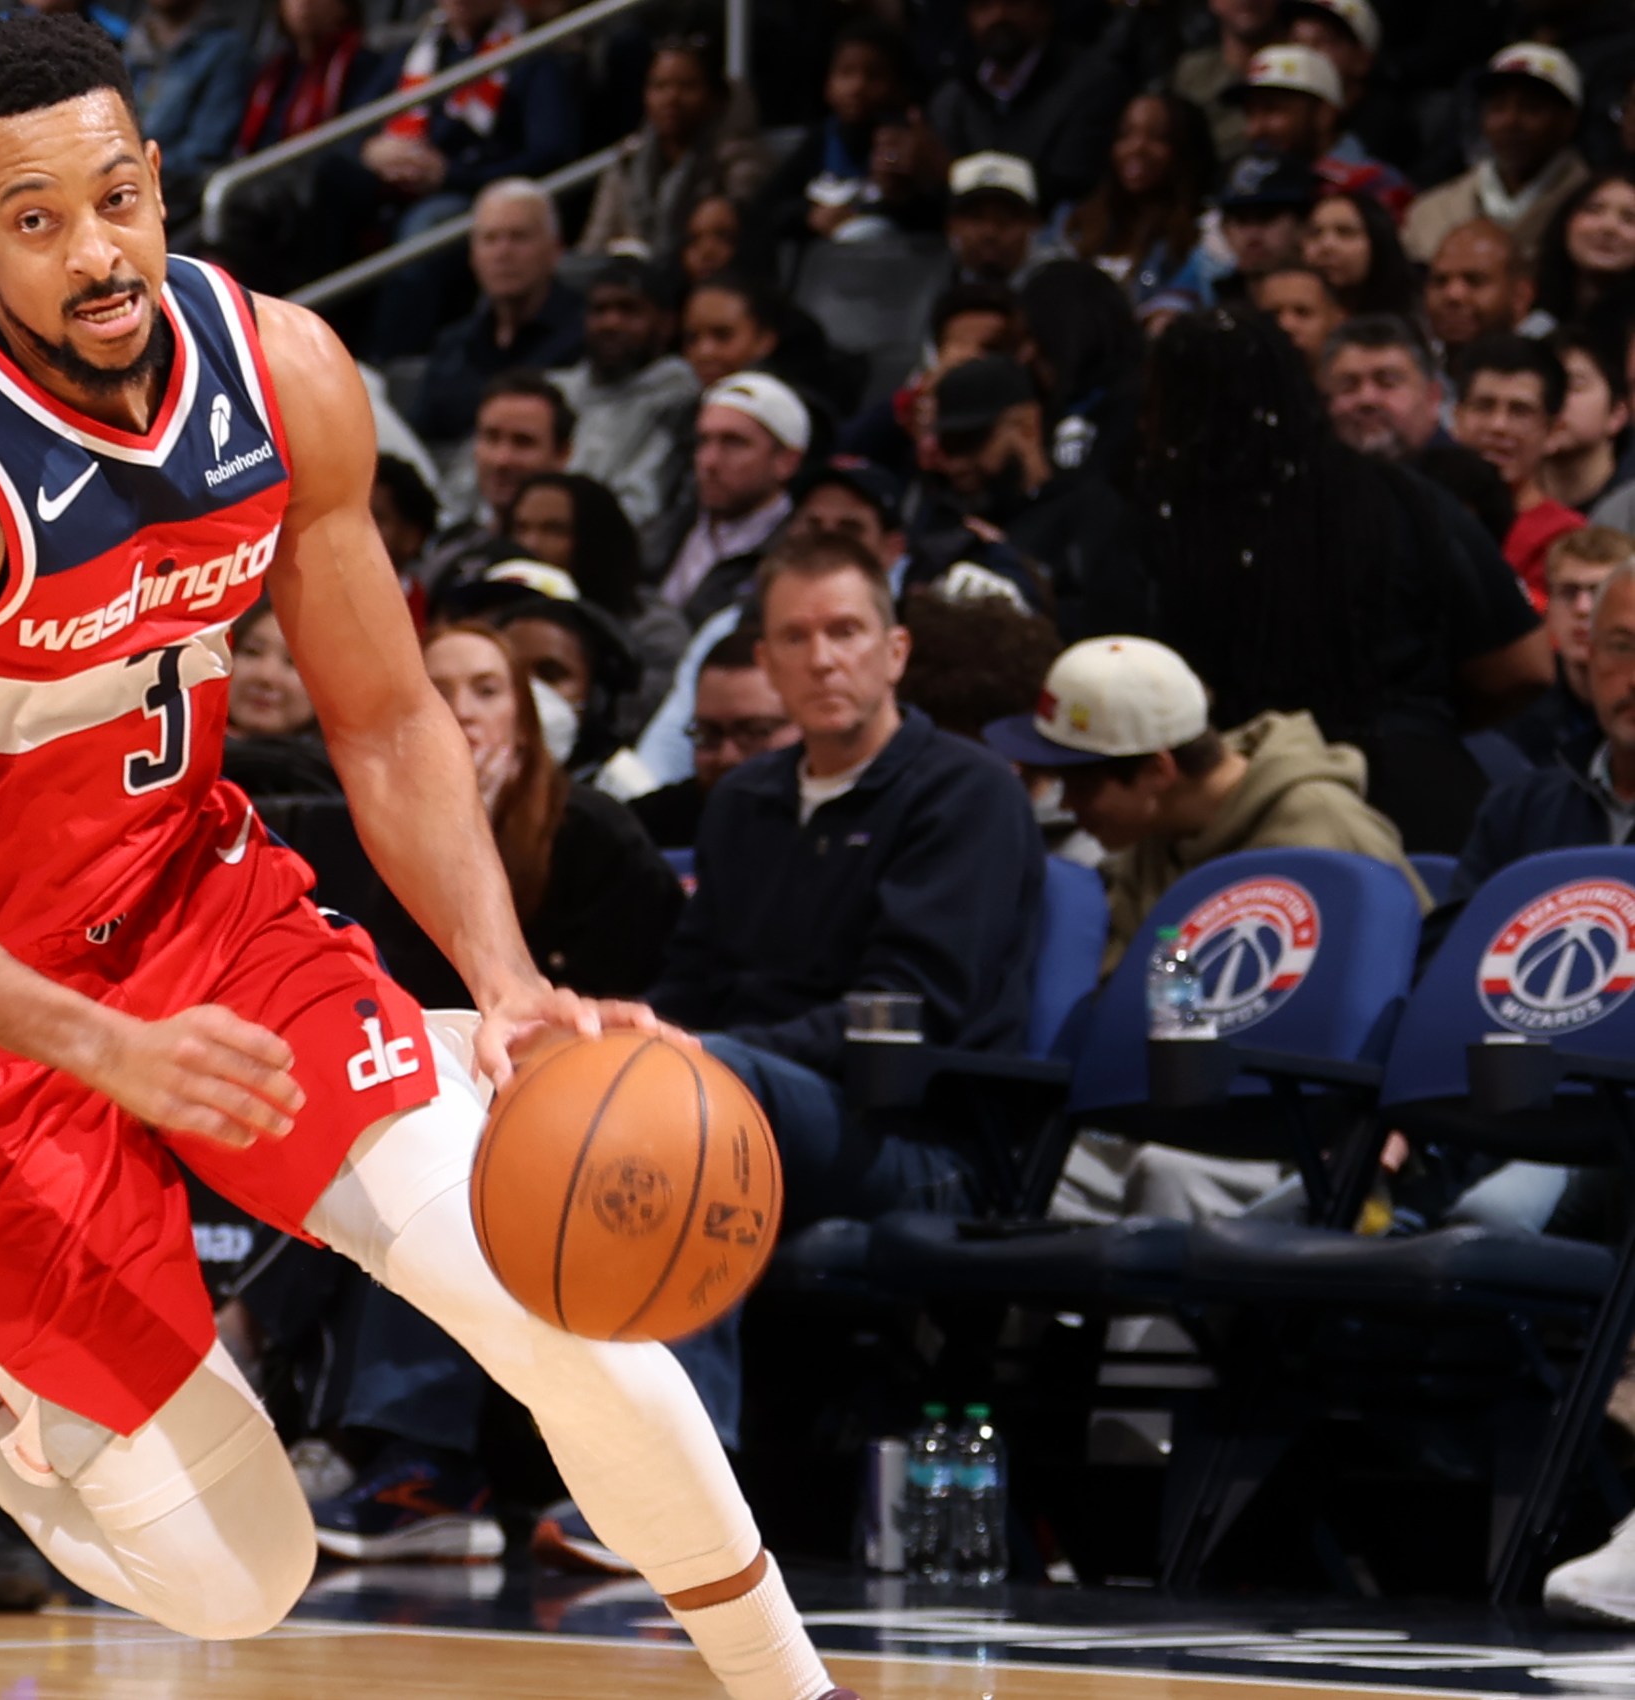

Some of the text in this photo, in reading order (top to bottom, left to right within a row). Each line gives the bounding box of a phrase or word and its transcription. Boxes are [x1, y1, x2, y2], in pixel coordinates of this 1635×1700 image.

[204, 441, 274, 488] Robinhood
[18, 523, 282, 651] washingto
[123, 643, 191, 796] 3
[1500, 995, 1603, 1029] WIZARDS
[347, 1016, 421, 1092] dc
